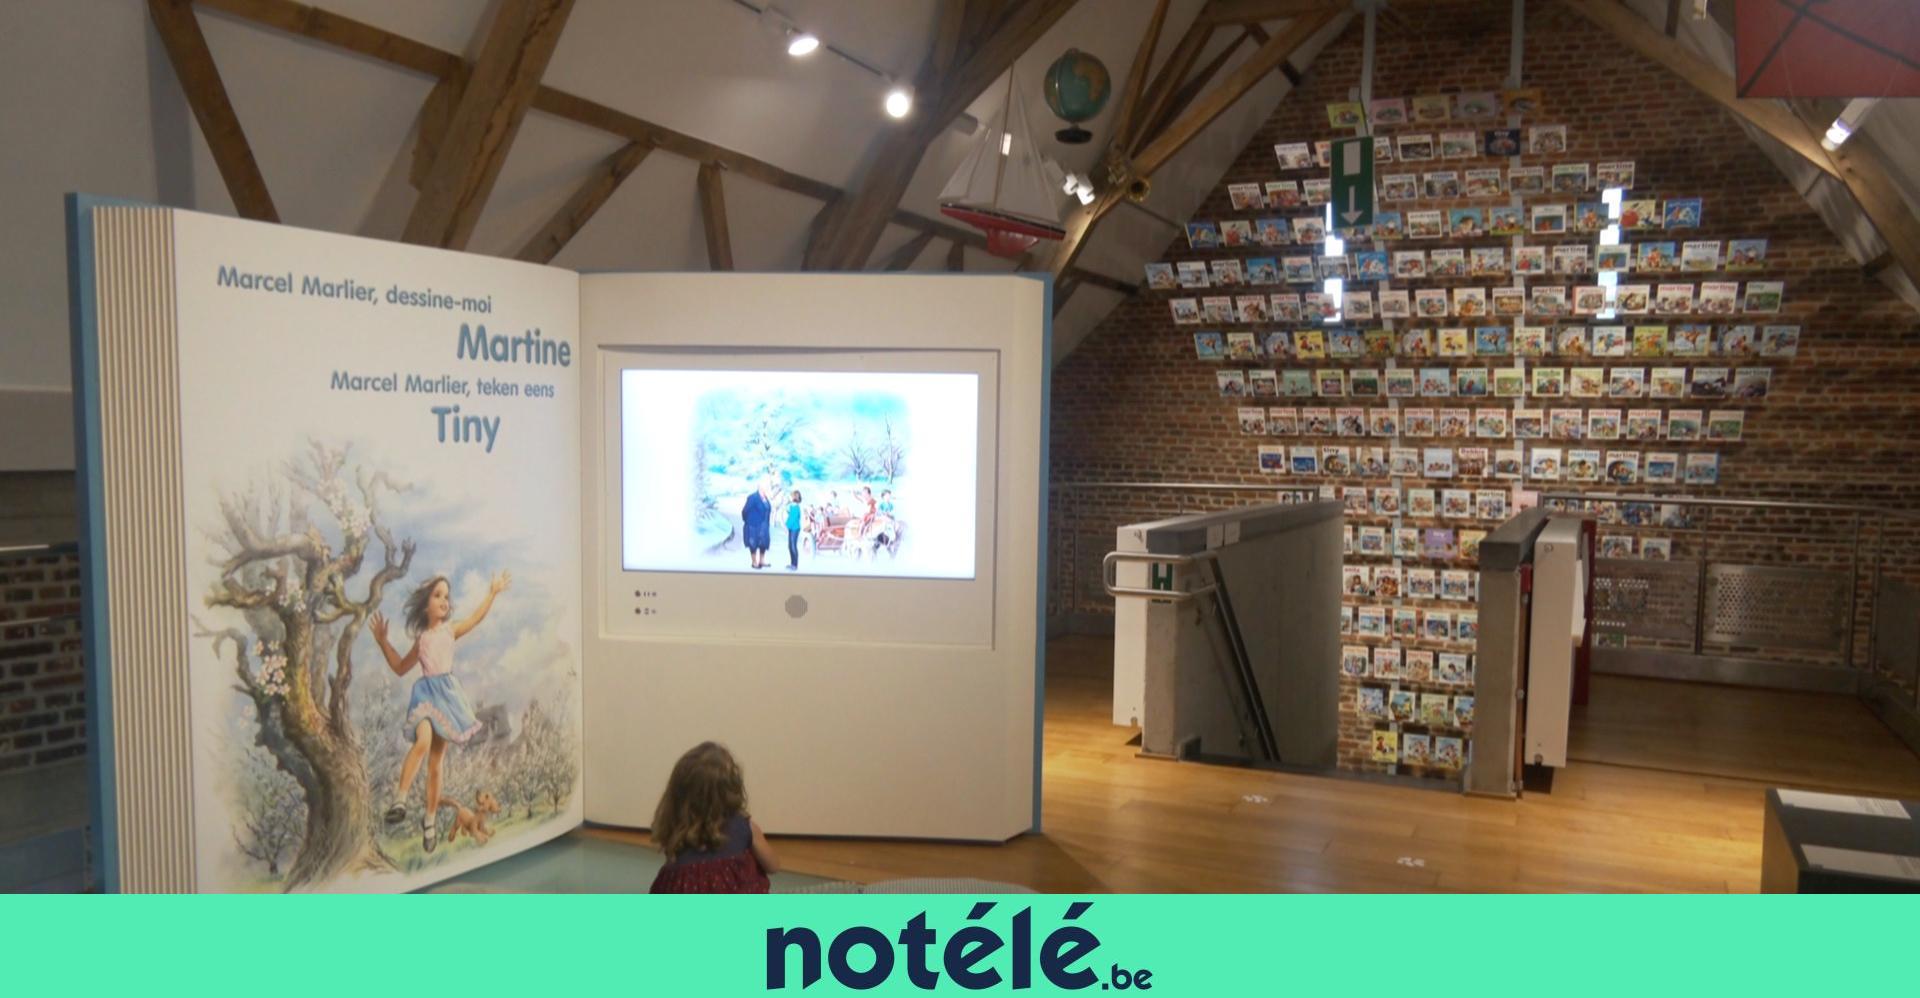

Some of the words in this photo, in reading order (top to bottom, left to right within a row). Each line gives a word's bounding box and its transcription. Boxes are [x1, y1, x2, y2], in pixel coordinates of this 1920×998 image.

[217, 265, 293, 294] Marcel
[301, 275, 379, 305] Marlier,
[386, 284, 492, 313] dessine-moi
[456, 322, 571, 367] Martine
[330, 370, 398, 392] Marcel
[405, 374, 471, 397] Marlier,
[477, 377, 519, 397] teken
[524, 382, 555, 398] eens
[431, 405, 501, 453] Tiny
